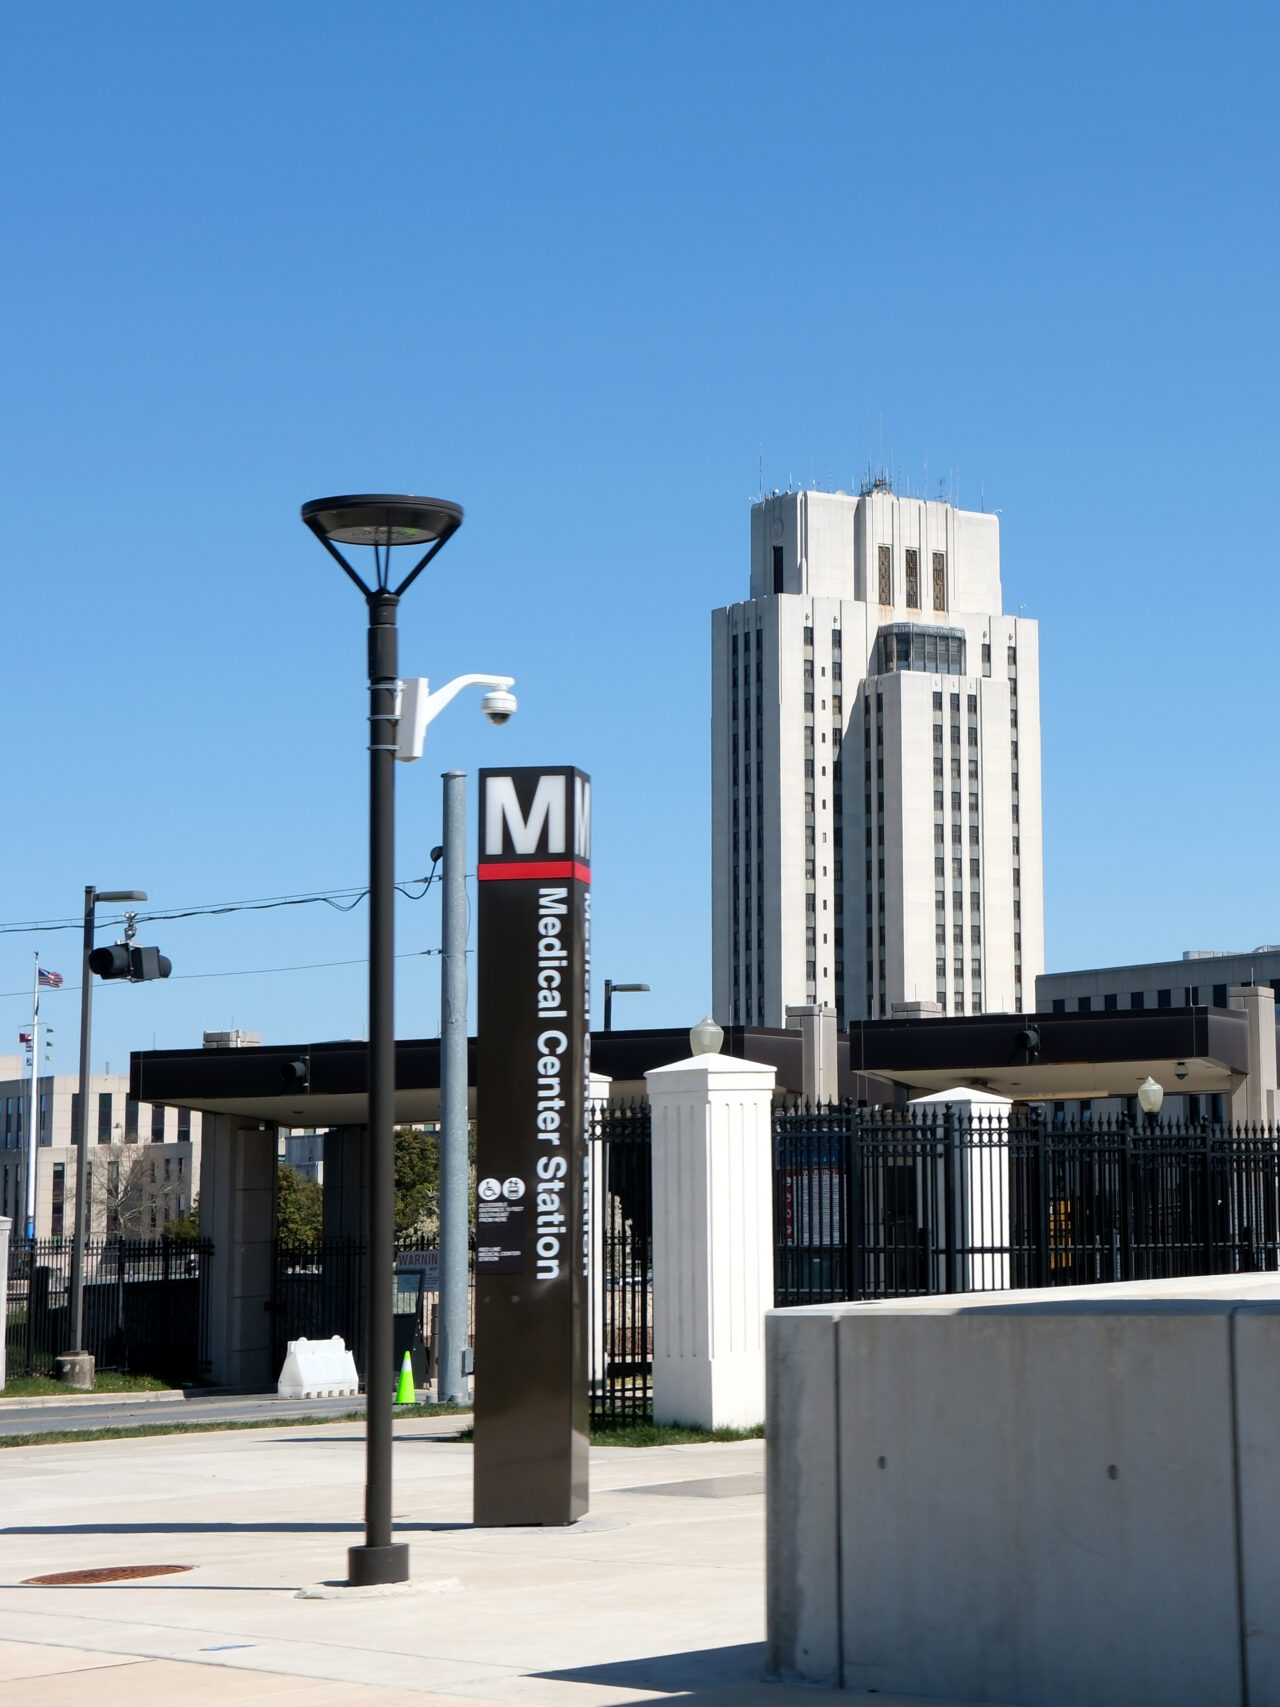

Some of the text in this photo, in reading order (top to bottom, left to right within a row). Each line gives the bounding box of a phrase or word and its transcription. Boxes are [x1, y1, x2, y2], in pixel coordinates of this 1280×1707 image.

[485, 774, 566, 854] M
[574, 776, 591, 861] M
[536, 887, 568, 1280] Medical Center Station
[399, 1253, 438, 1266] WARNIN
